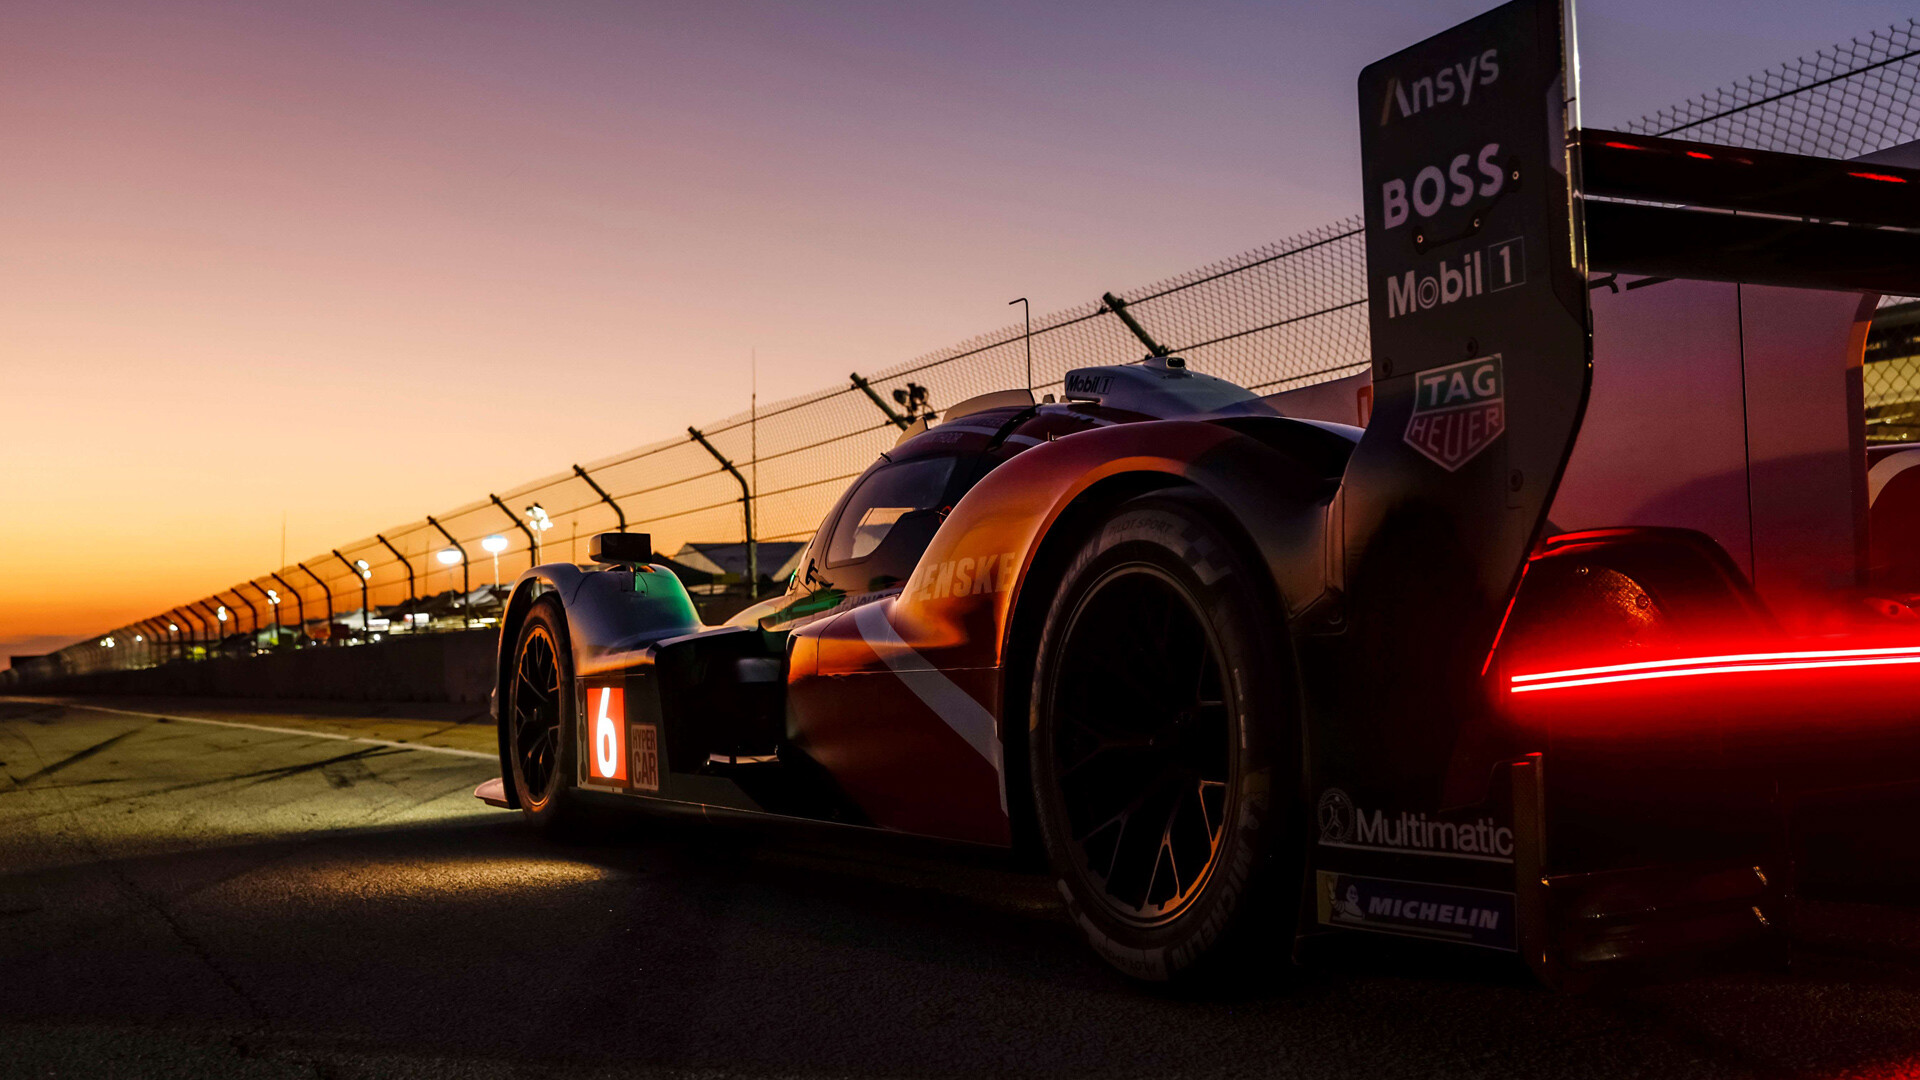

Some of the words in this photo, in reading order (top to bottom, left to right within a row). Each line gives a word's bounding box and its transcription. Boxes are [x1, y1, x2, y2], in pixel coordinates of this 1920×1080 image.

[1380, 48, 1500, 126] Ansys
[1382, 142, 1504, 230] BOSS
[1387, 250, 1483, 319] Mobil
[1066, 374, 1101, 393] Mobil
[1422, 364, 1496, 406] TAG
[1410, 407, 1499, 461] HEUER
[596, 687, 618, 778] 6
[632, 727, 656, 750] HYPER
[633, 751, 657, 786] CAR
[1355, 807, 1515, 856] Multimatic
[1368, 896, 1500, 931] MICHELIN
